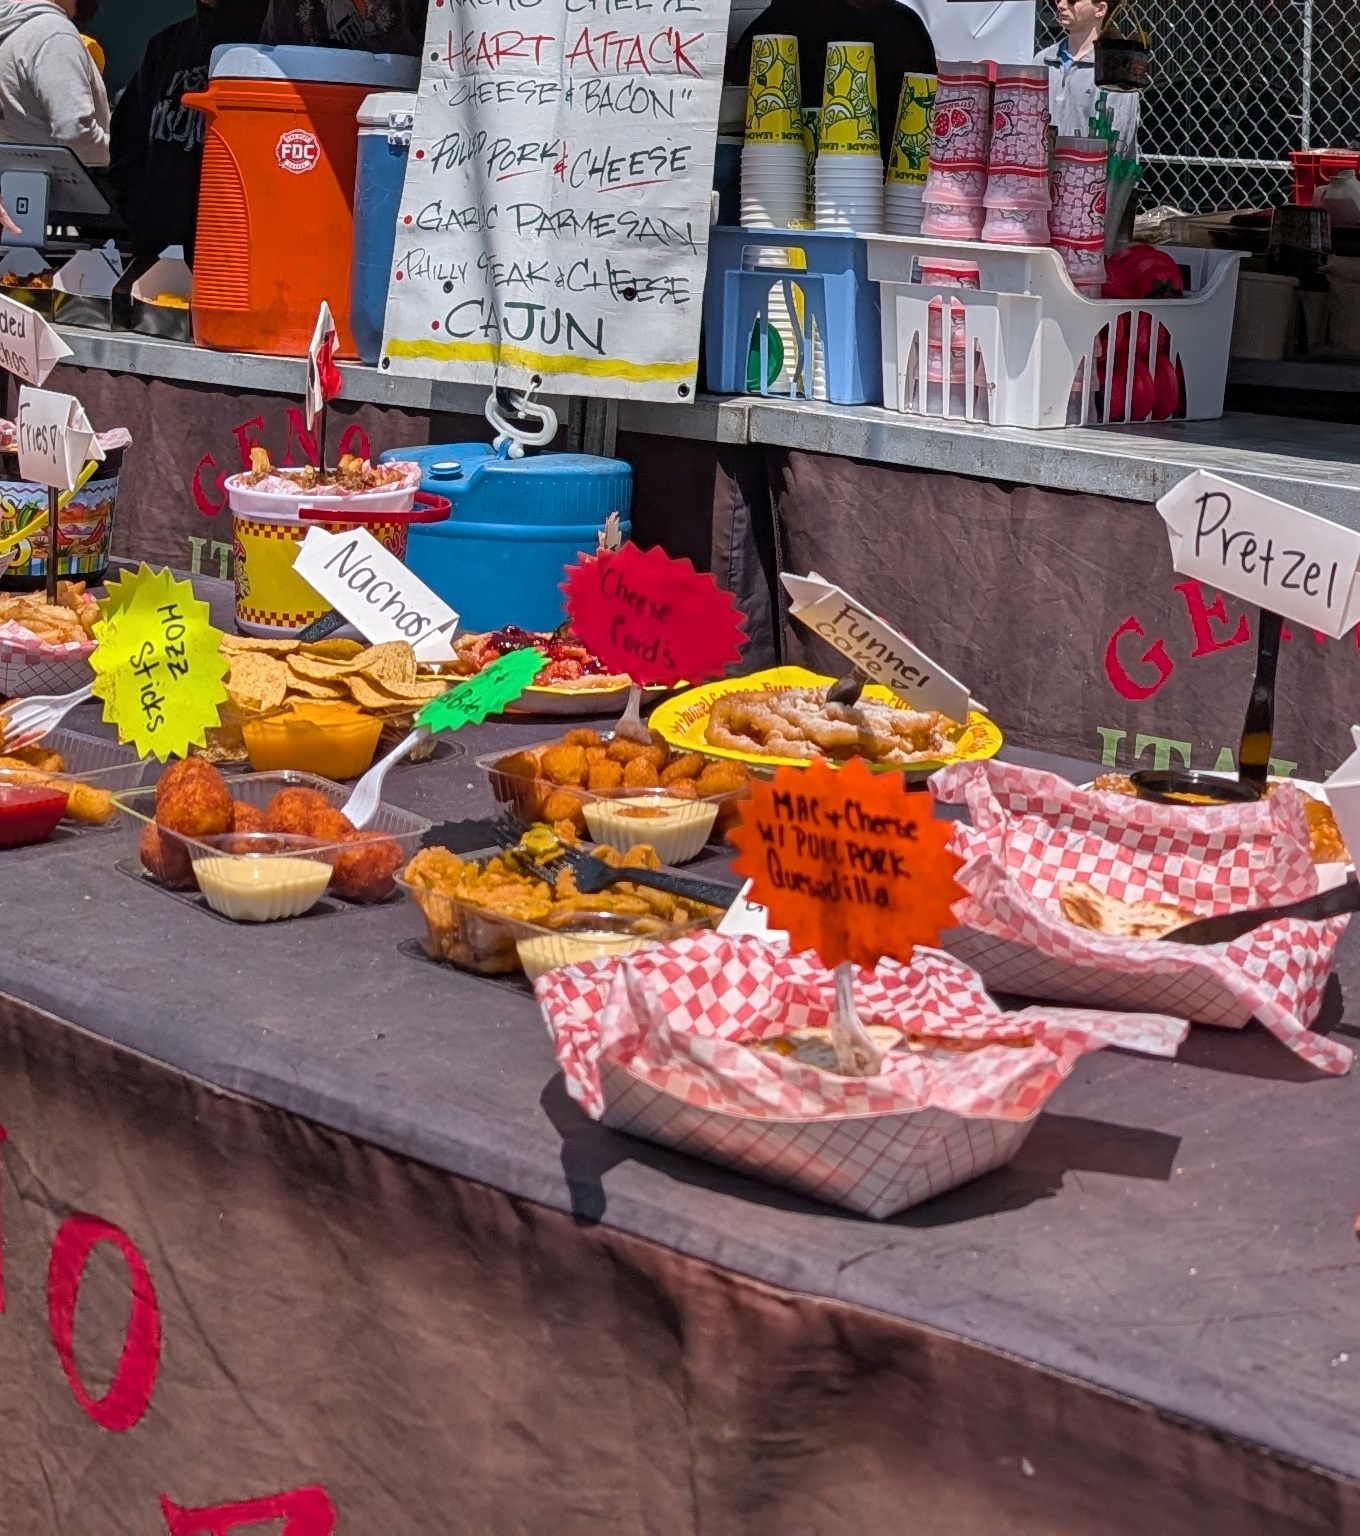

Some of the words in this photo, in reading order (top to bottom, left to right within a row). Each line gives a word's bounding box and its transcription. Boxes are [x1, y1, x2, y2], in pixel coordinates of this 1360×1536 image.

[442, 29, 555, 71] HEART
[565, 27, 704, 76] ATTACK
[281, 144, 315, 159] FDC
[431, 130, 487, 174] PULLED
[487, 138, 560, 179] PORK
[569, 146, 691, 188] CHEESE
[506, 202, 698, 255] PARMESAN
[397, 248, 468, 284] PHILLY
[566, 258, 691, 305] CHEESE
[445, 298, 606, 355] CAJUN
[1195, 491, 1338, 608] Pretzel
[323, 539, 433, 639] Nachos
[599, 567, 673, 630] Cheese
[837, 603, 931, 691] Funnel
[772, 788, 821, 825] MAC
[843, 800, 918, 841] Cheese
[766, 848, 891, 906] Quesadilla
[847, 842, 912, 879] PORK
